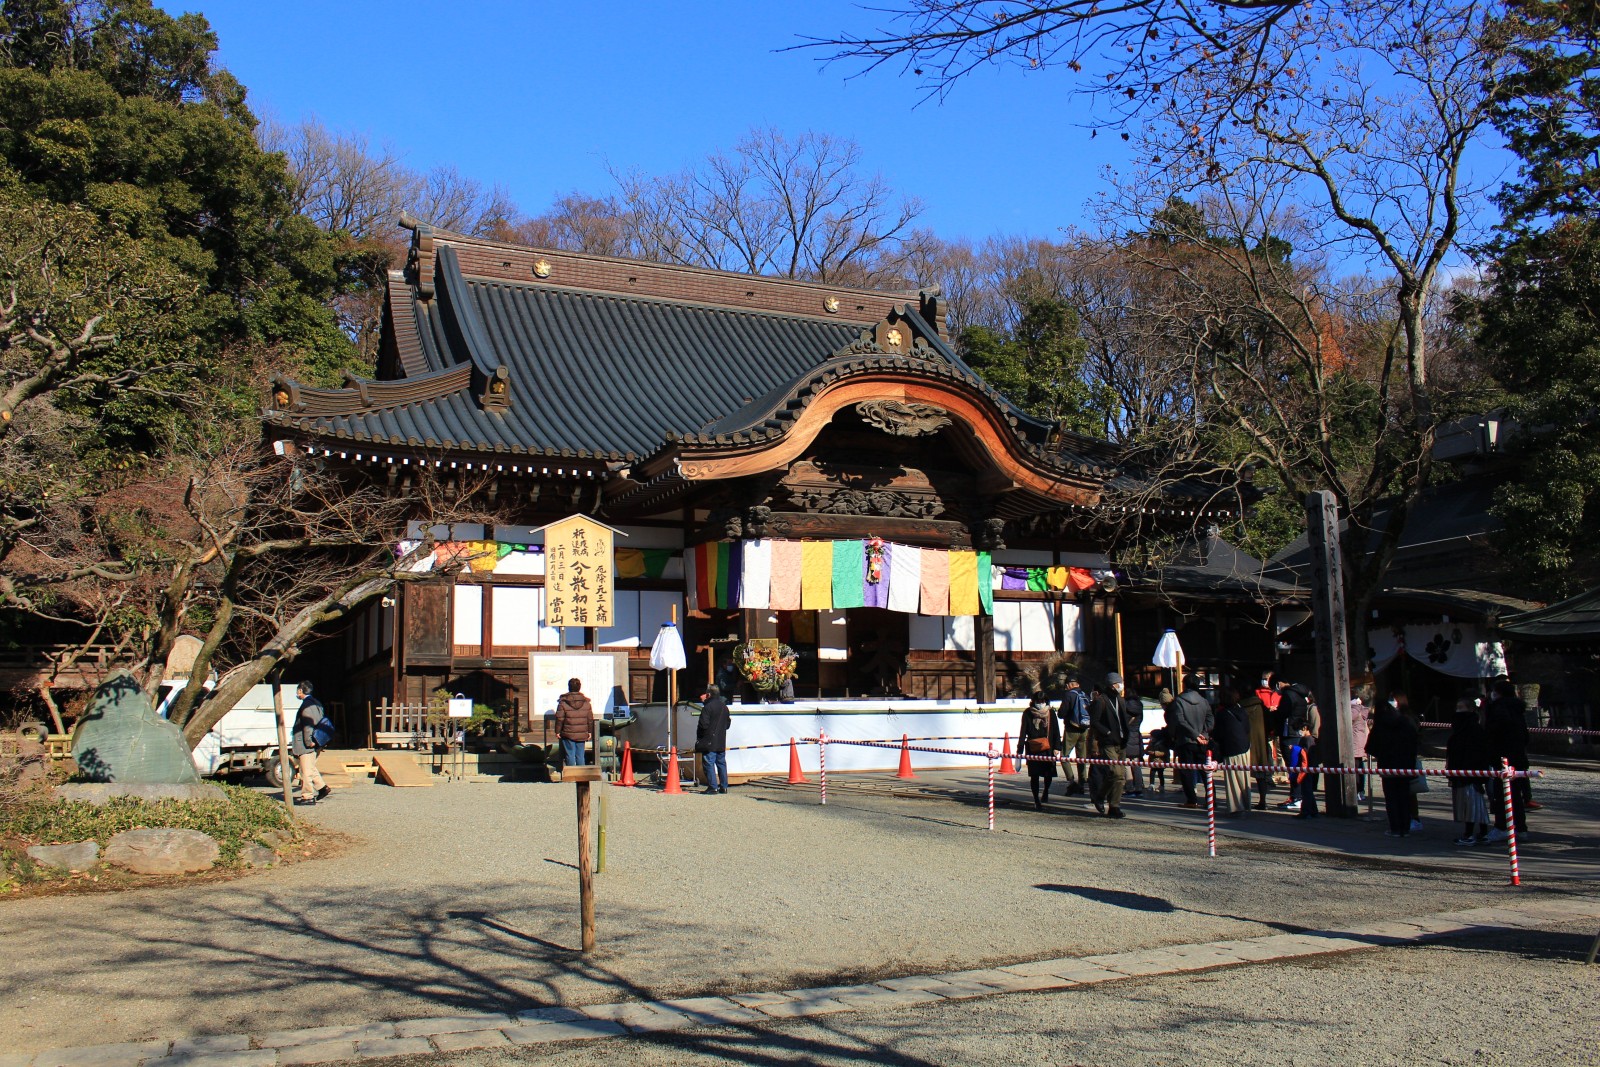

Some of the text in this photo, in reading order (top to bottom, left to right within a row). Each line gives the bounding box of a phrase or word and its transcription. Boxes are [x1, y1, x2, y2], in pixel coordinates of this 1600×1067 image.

[569, 560, 591, 624] 分散初詣
[595, 565, 608, 625] 厄除元三大師
